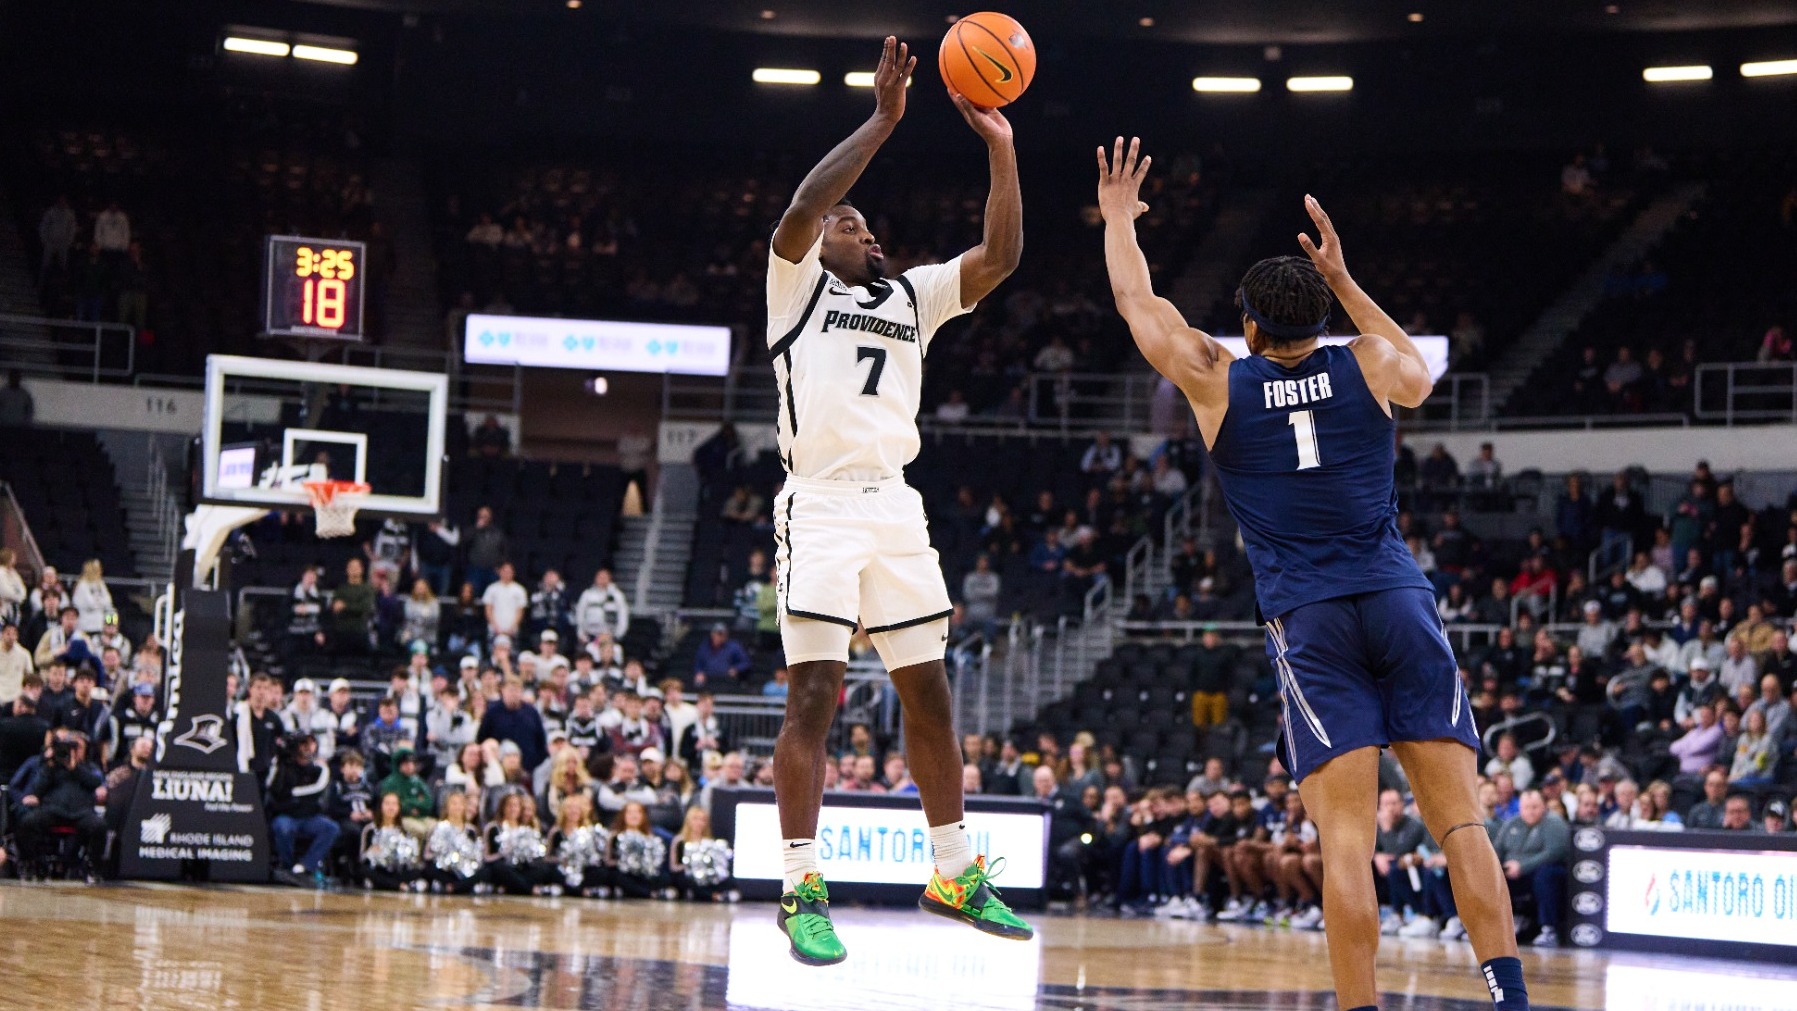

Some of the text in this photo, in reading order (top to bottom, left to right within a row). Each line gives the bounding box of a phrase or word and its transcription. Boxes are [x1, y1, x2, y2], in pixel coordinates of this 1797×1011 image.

[296, 247, 354, 280] 3:25
[303, 279, 345, 328] 18
[821, 310, 916, 343] PROVIDENCE
[855, 345, 887, 397] 7
[147, 398, 177, 415] 116
[1263, 372, 1333, 408] FOSTER
[1288, 409, 1321, 470] 1
[139, 846, 253, 862] MEDICAL IMAGING
[169, 832, 254, 847] RHODE ISLAND
[820, 824, 935, 864] SANTOR
[1669, 869, 1764, 918] SANTORO
